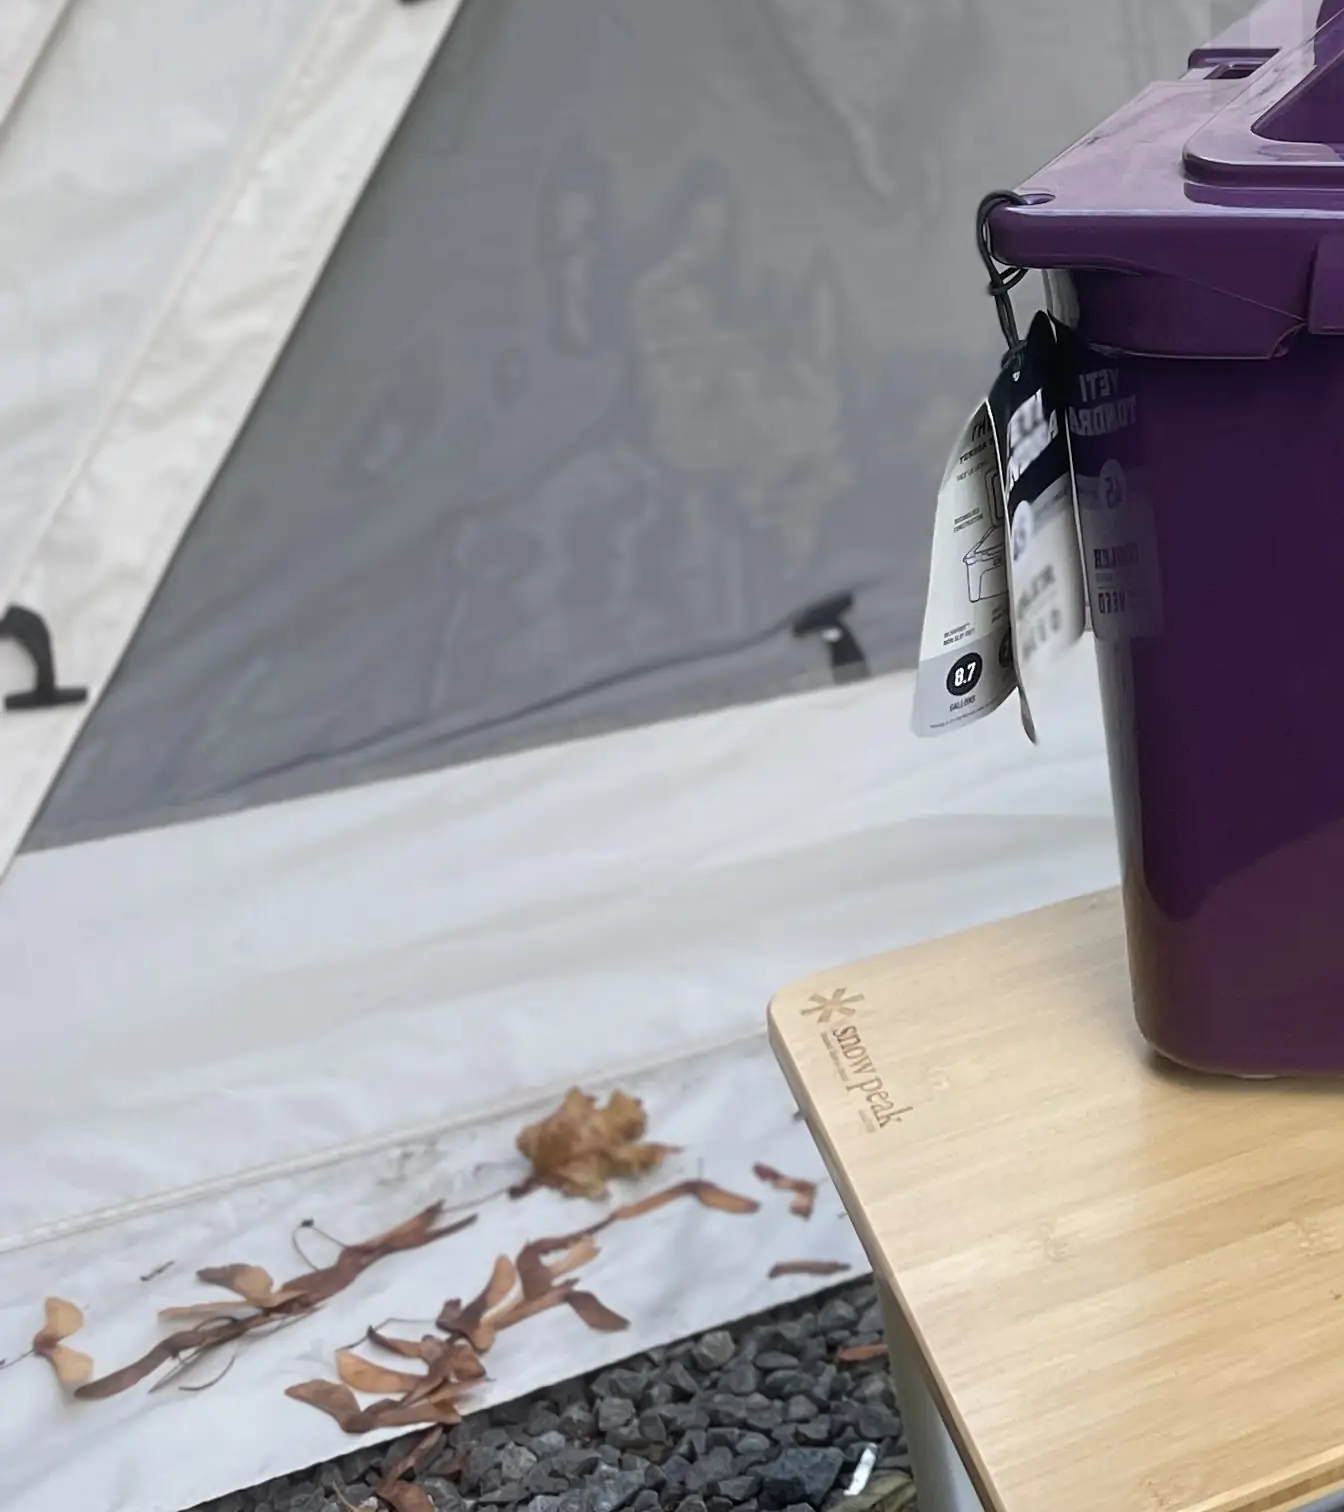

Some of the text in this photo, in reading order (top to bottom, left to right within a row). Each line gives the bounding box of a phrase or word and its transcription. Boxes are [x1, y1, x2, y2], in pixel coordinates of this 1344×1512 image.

[954, 661, 976, 687] 8.7
[832, 1024, 878, 1076] snow
[846, 1075, 914, 1129] peak
